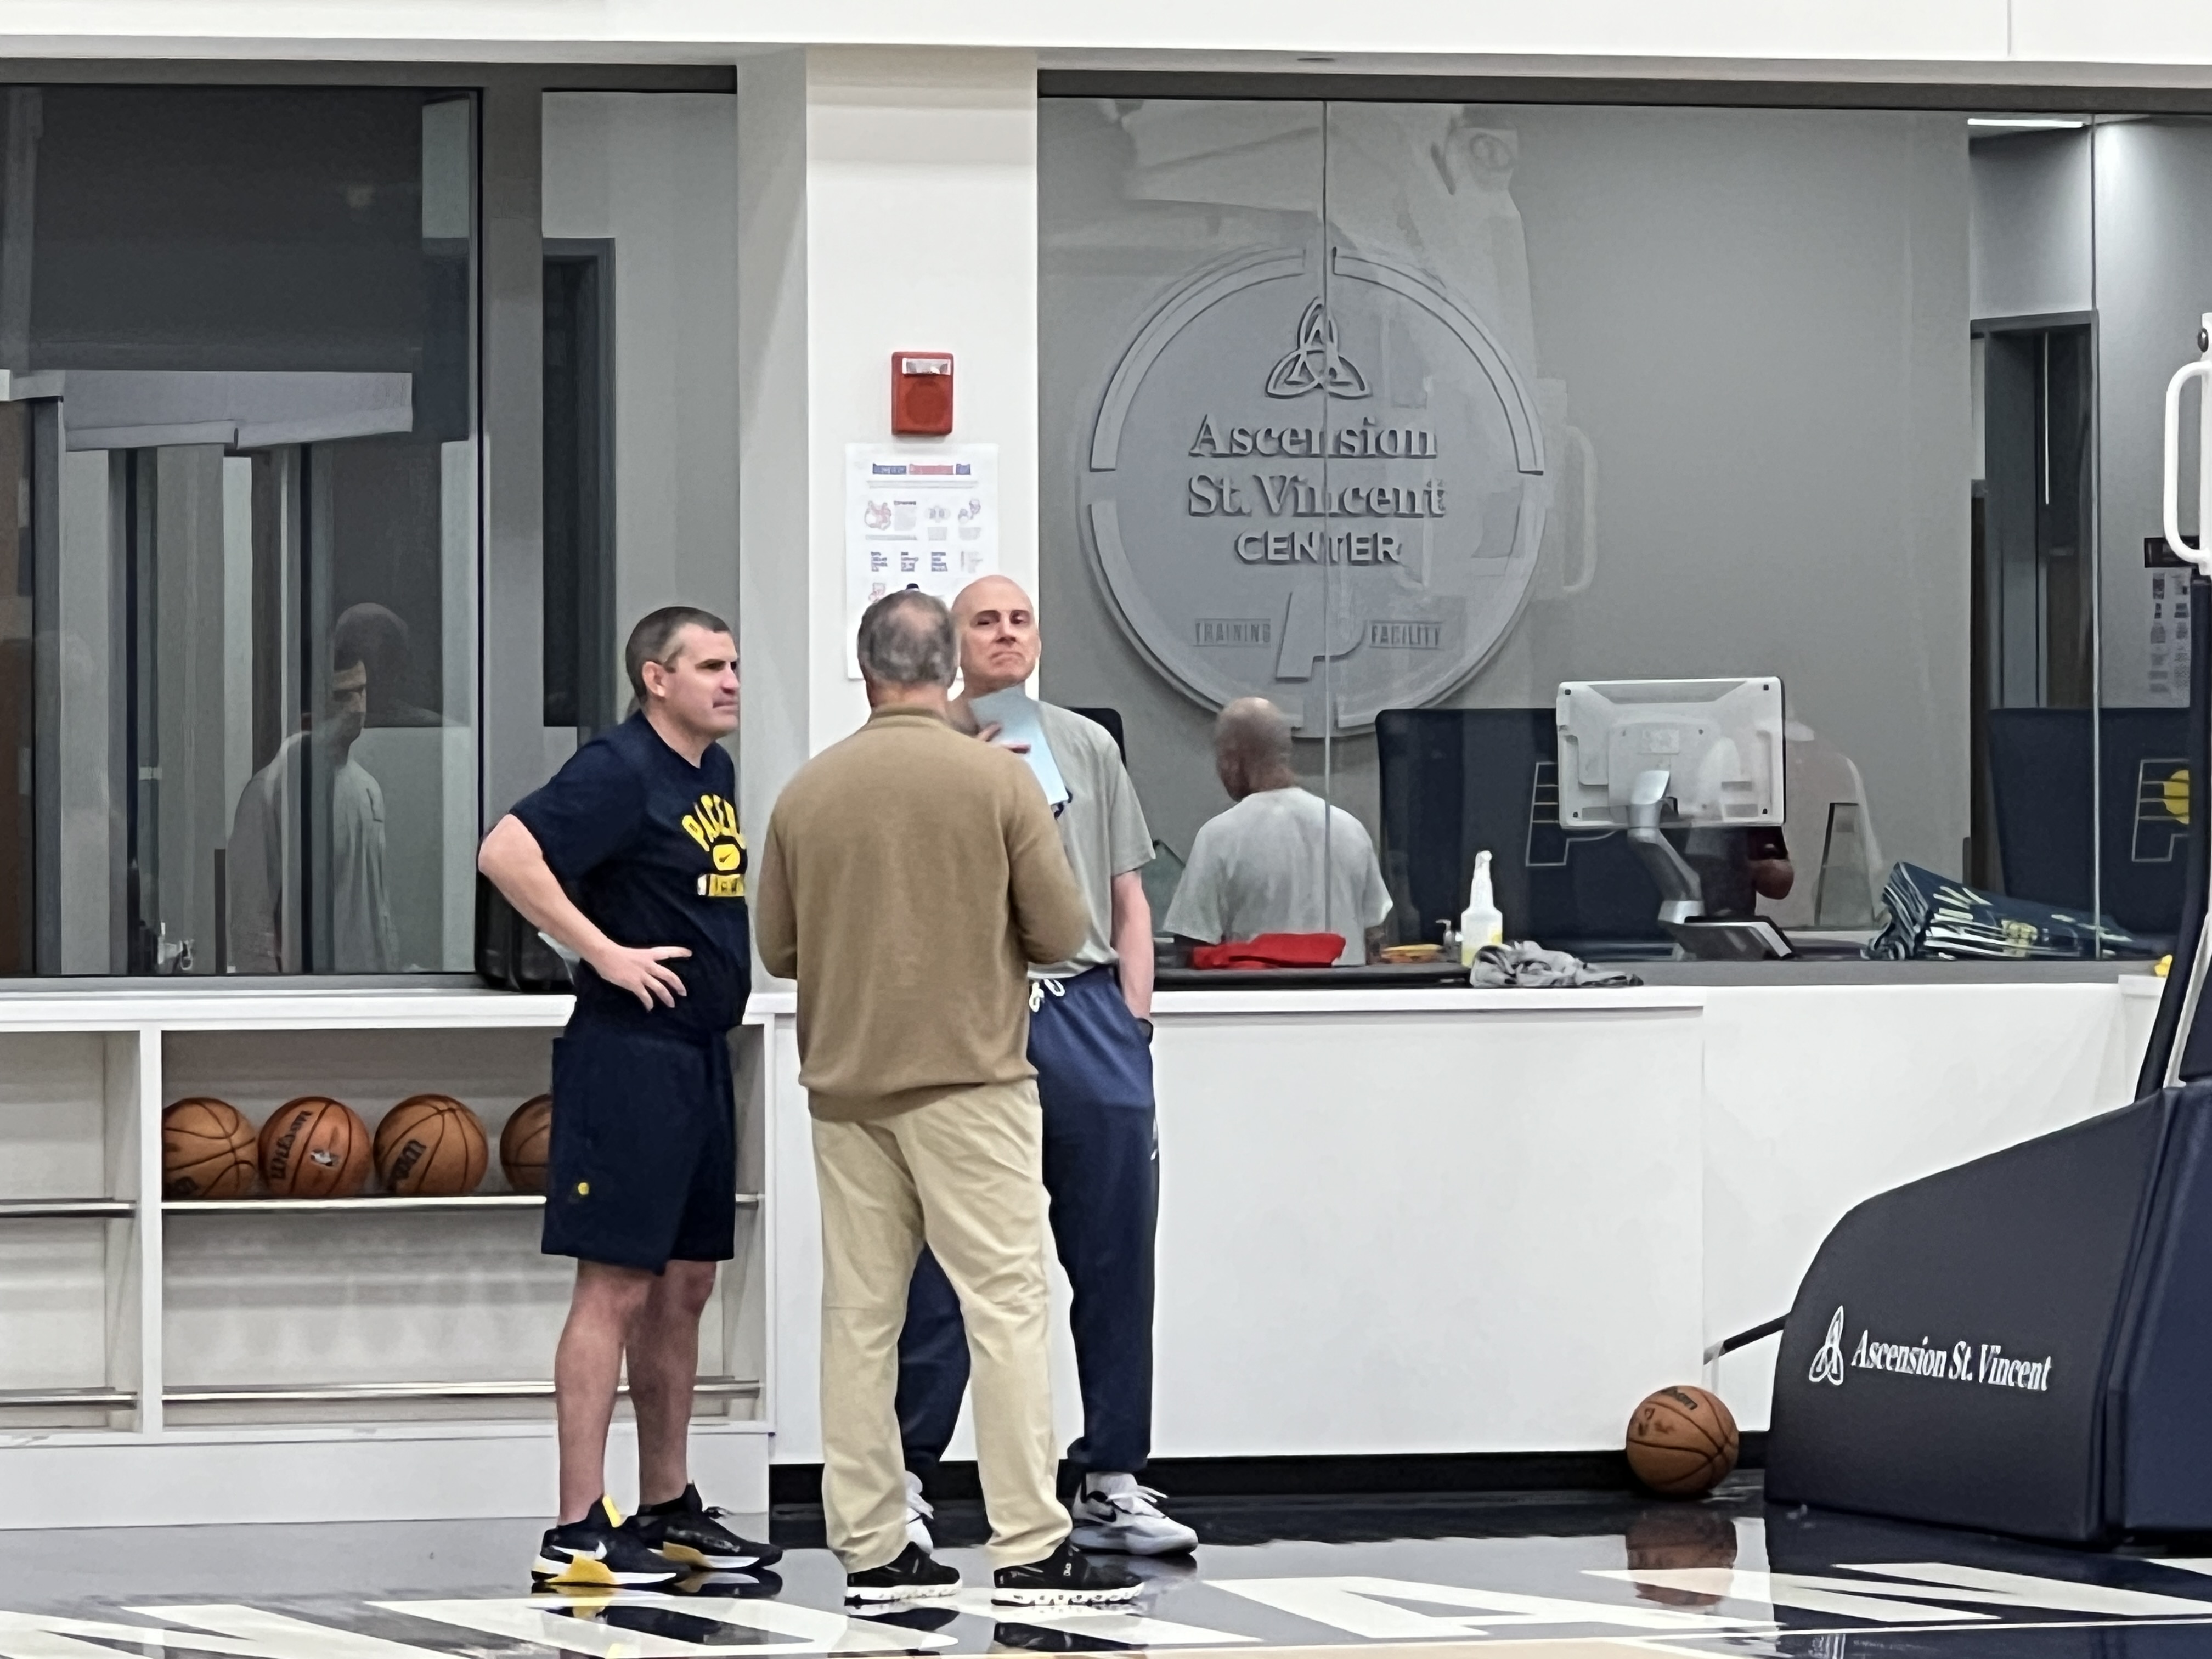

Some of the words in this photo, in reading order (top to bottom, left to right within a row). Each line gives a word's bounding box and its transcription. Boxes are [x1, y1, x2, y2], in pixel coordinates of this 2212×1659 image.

[1188, 414, 1437, 459] Ascension
[1188, 475, 1251, 517] St.
[1252, 474, 1446, 518] Vincent
[1234, 530, 1402, 566] CENTER
[1194, 622, 1271, 643] TRAINING
[1372, 624, 1440, 646] FACILITY
[1850, 1329, 1948, 1378] Ascension
[1948, 1340, 1973, 1381] St.
[1978, 1344, 2052, 1391] Vincent
[0, 1557, 2212, 1659] NDIAN
